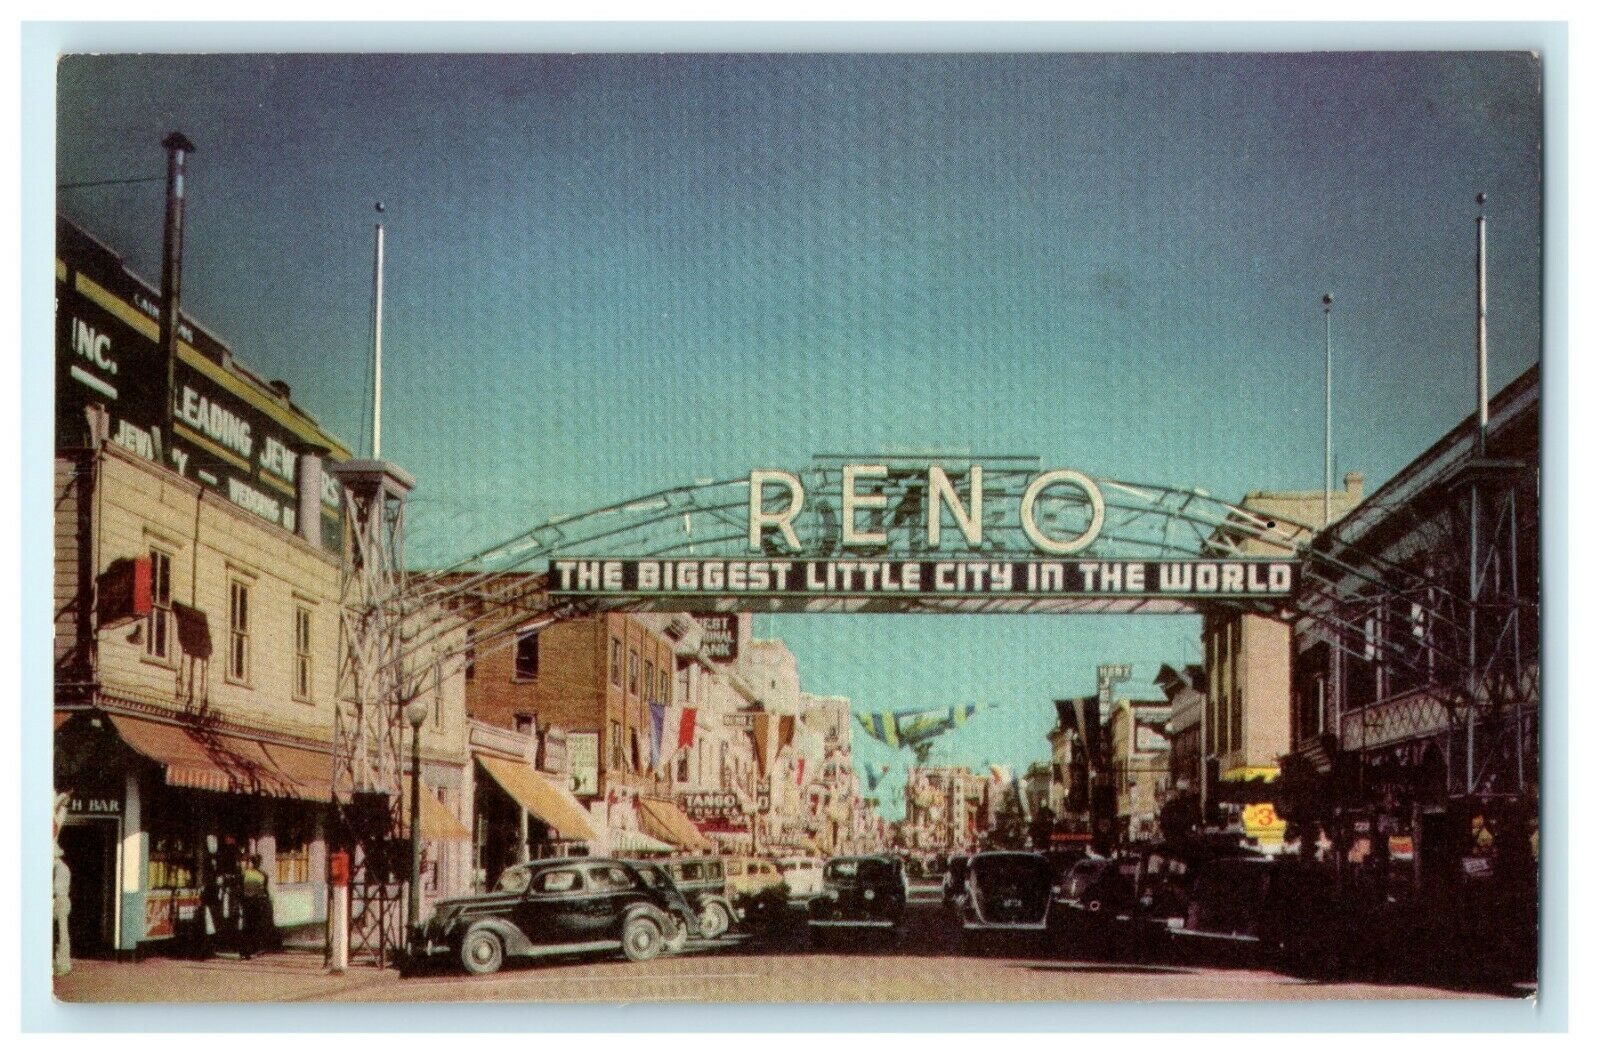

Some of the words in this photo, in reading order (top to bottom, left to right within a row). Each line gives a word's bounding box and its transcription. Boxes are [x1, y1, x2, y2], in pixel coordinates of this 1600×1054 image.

[71, 316, 118, 375] INC.
[174, 385, 253, 458] LEADING
[260, 436, 340, 508] JEWRS
[748, 463, 1105, 554] RENO
[555, 561, 624, 591] THE
[637, 561, 793, 592] BIGGEST
[805, 561, 922, 592] LITTLE
[934, 562, 1014, 592] CITY
[1078, 563, 1146, 592] THE
[1159, 563, 1293, 593] WORLD
[89, 799, 120, 812] BAR
